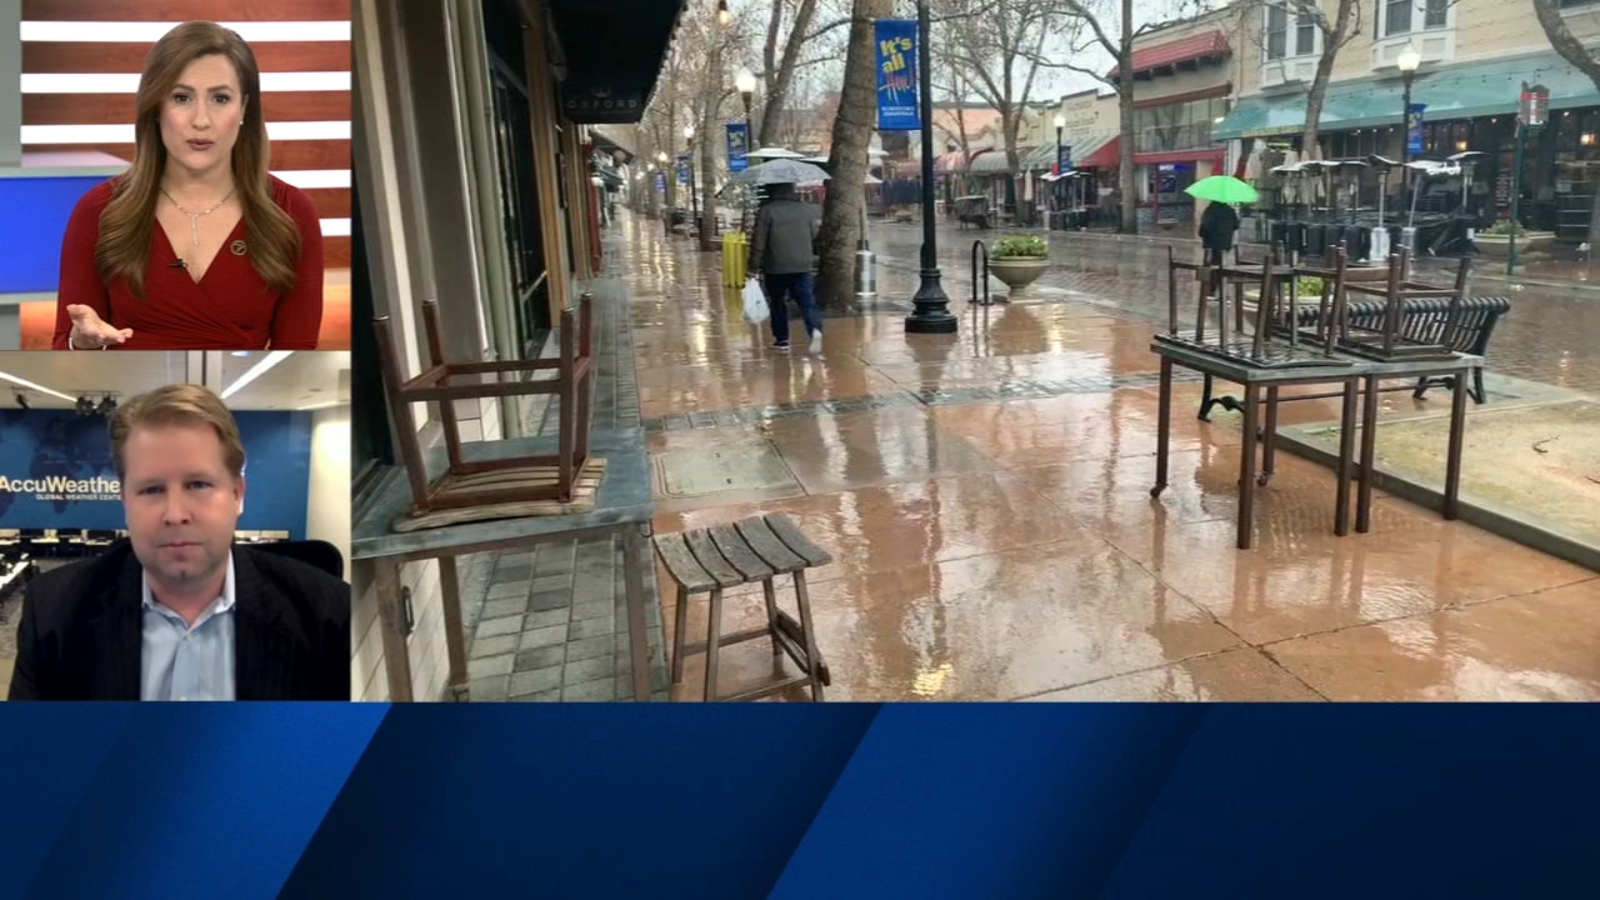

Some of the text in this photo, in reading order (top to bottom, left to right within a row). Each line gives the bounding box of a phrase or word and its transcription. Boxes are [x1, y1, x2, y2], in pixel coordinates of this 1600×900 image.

[880, 37, 911, 56] It's
[882, 53, 905, 72] all
[569, 99, 637, 108] OXFORD
[0, 475, 121, 493] AccuWeathe
